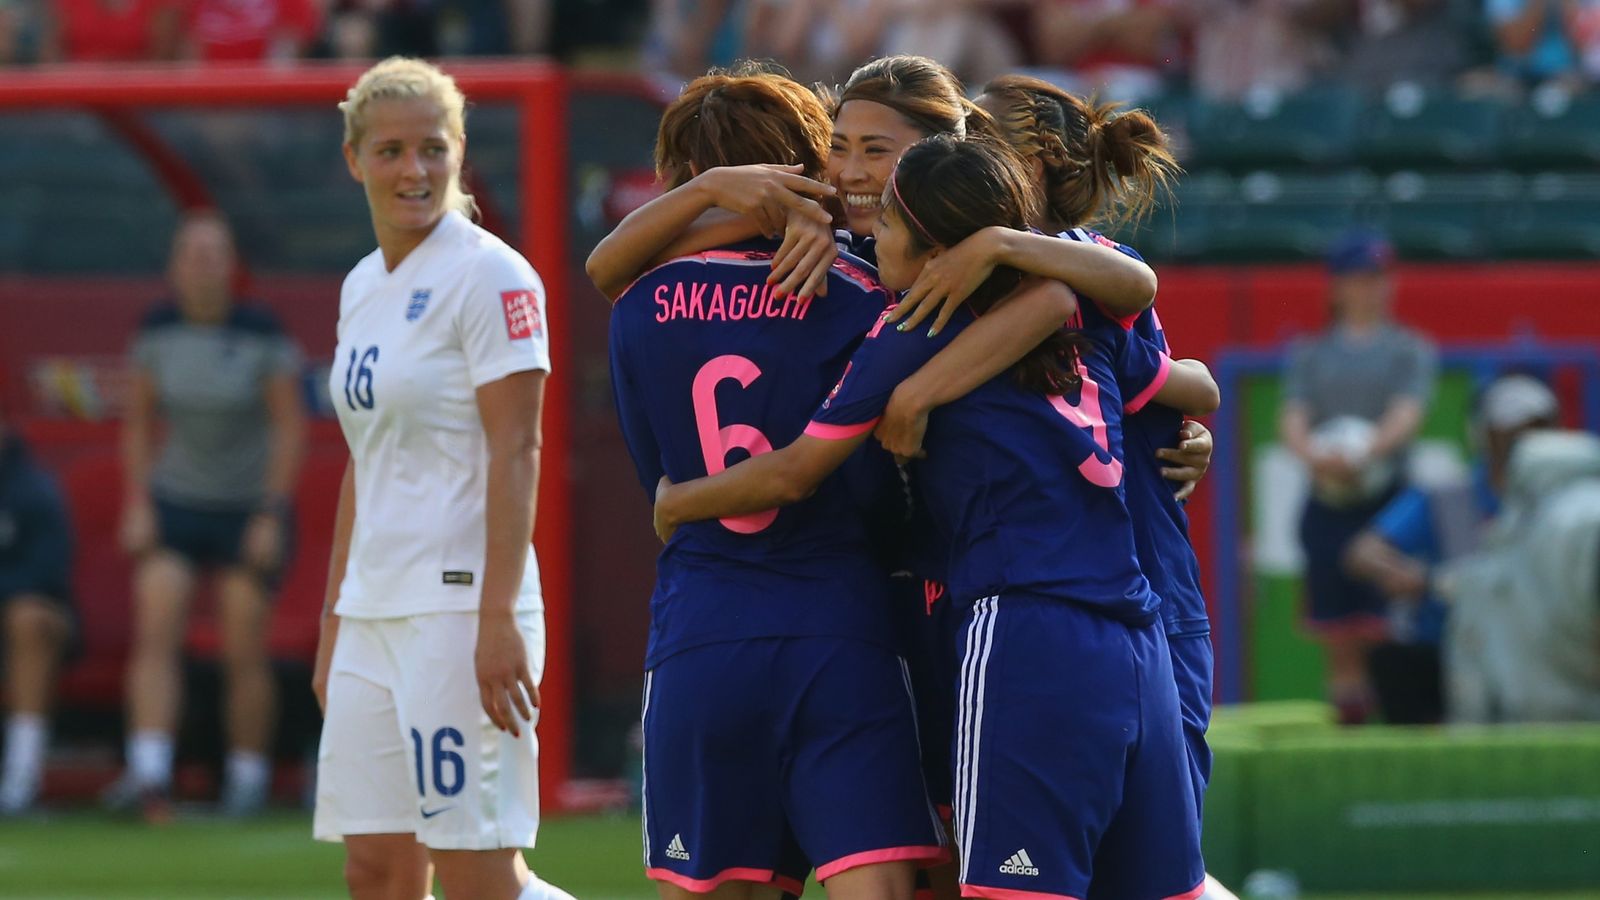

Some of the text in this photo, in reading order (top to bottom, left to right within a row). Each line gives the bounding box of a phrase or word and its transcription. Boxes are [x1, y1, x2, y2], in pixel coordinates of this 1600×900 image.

[654, 282, 815, 323] SAKAGUCHI
[345, 346, 379, 411] 16
[692, 354, 779, 534] 6
[1046, 354, 1123, 488] 9
[410, 726, 465, 797] 16
[665, 849, 690, 860] adidas
[999, 863, 1039, 876] adidas
